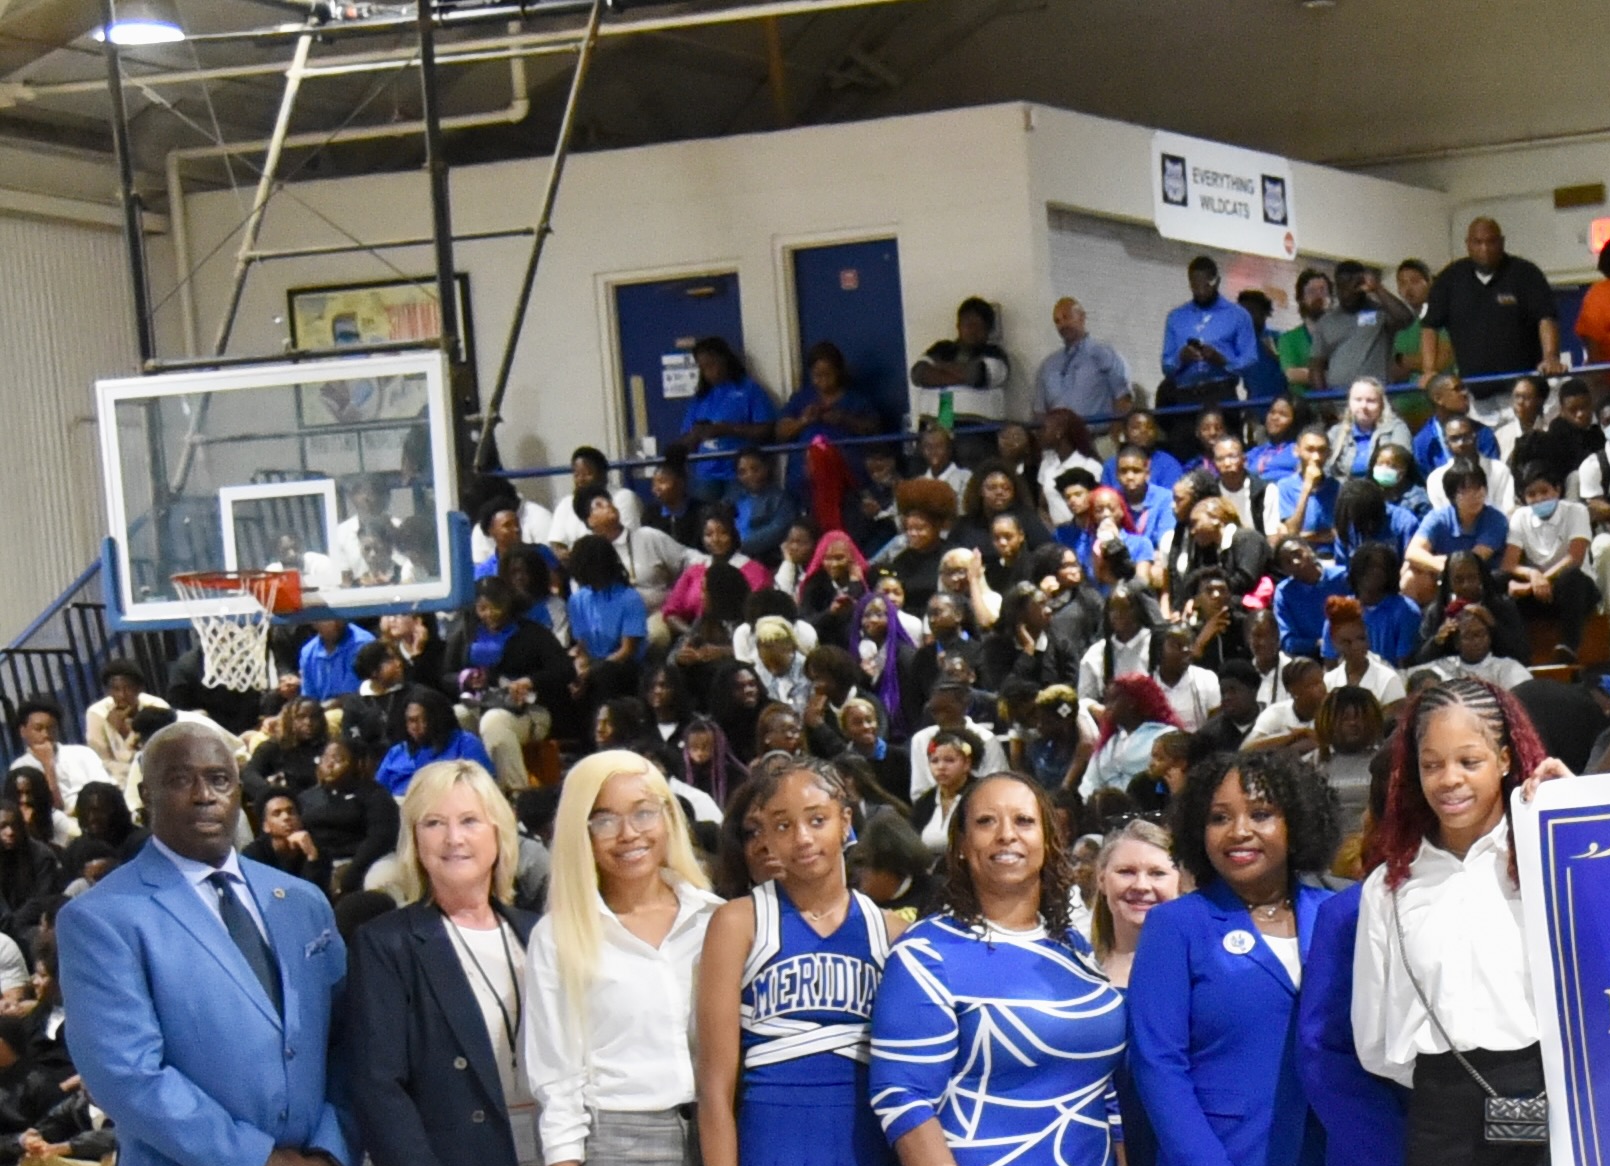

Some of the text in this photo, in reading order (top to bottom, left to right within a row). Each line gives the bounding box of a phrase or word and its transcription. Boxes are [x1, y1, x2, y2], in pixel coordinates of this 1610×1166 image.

[1192, 167, 1255, 195] EVERYTHING
[1200, 195, 1250, 219] WILDCATS
[751, 952, 882, 1025] MERIDIA
